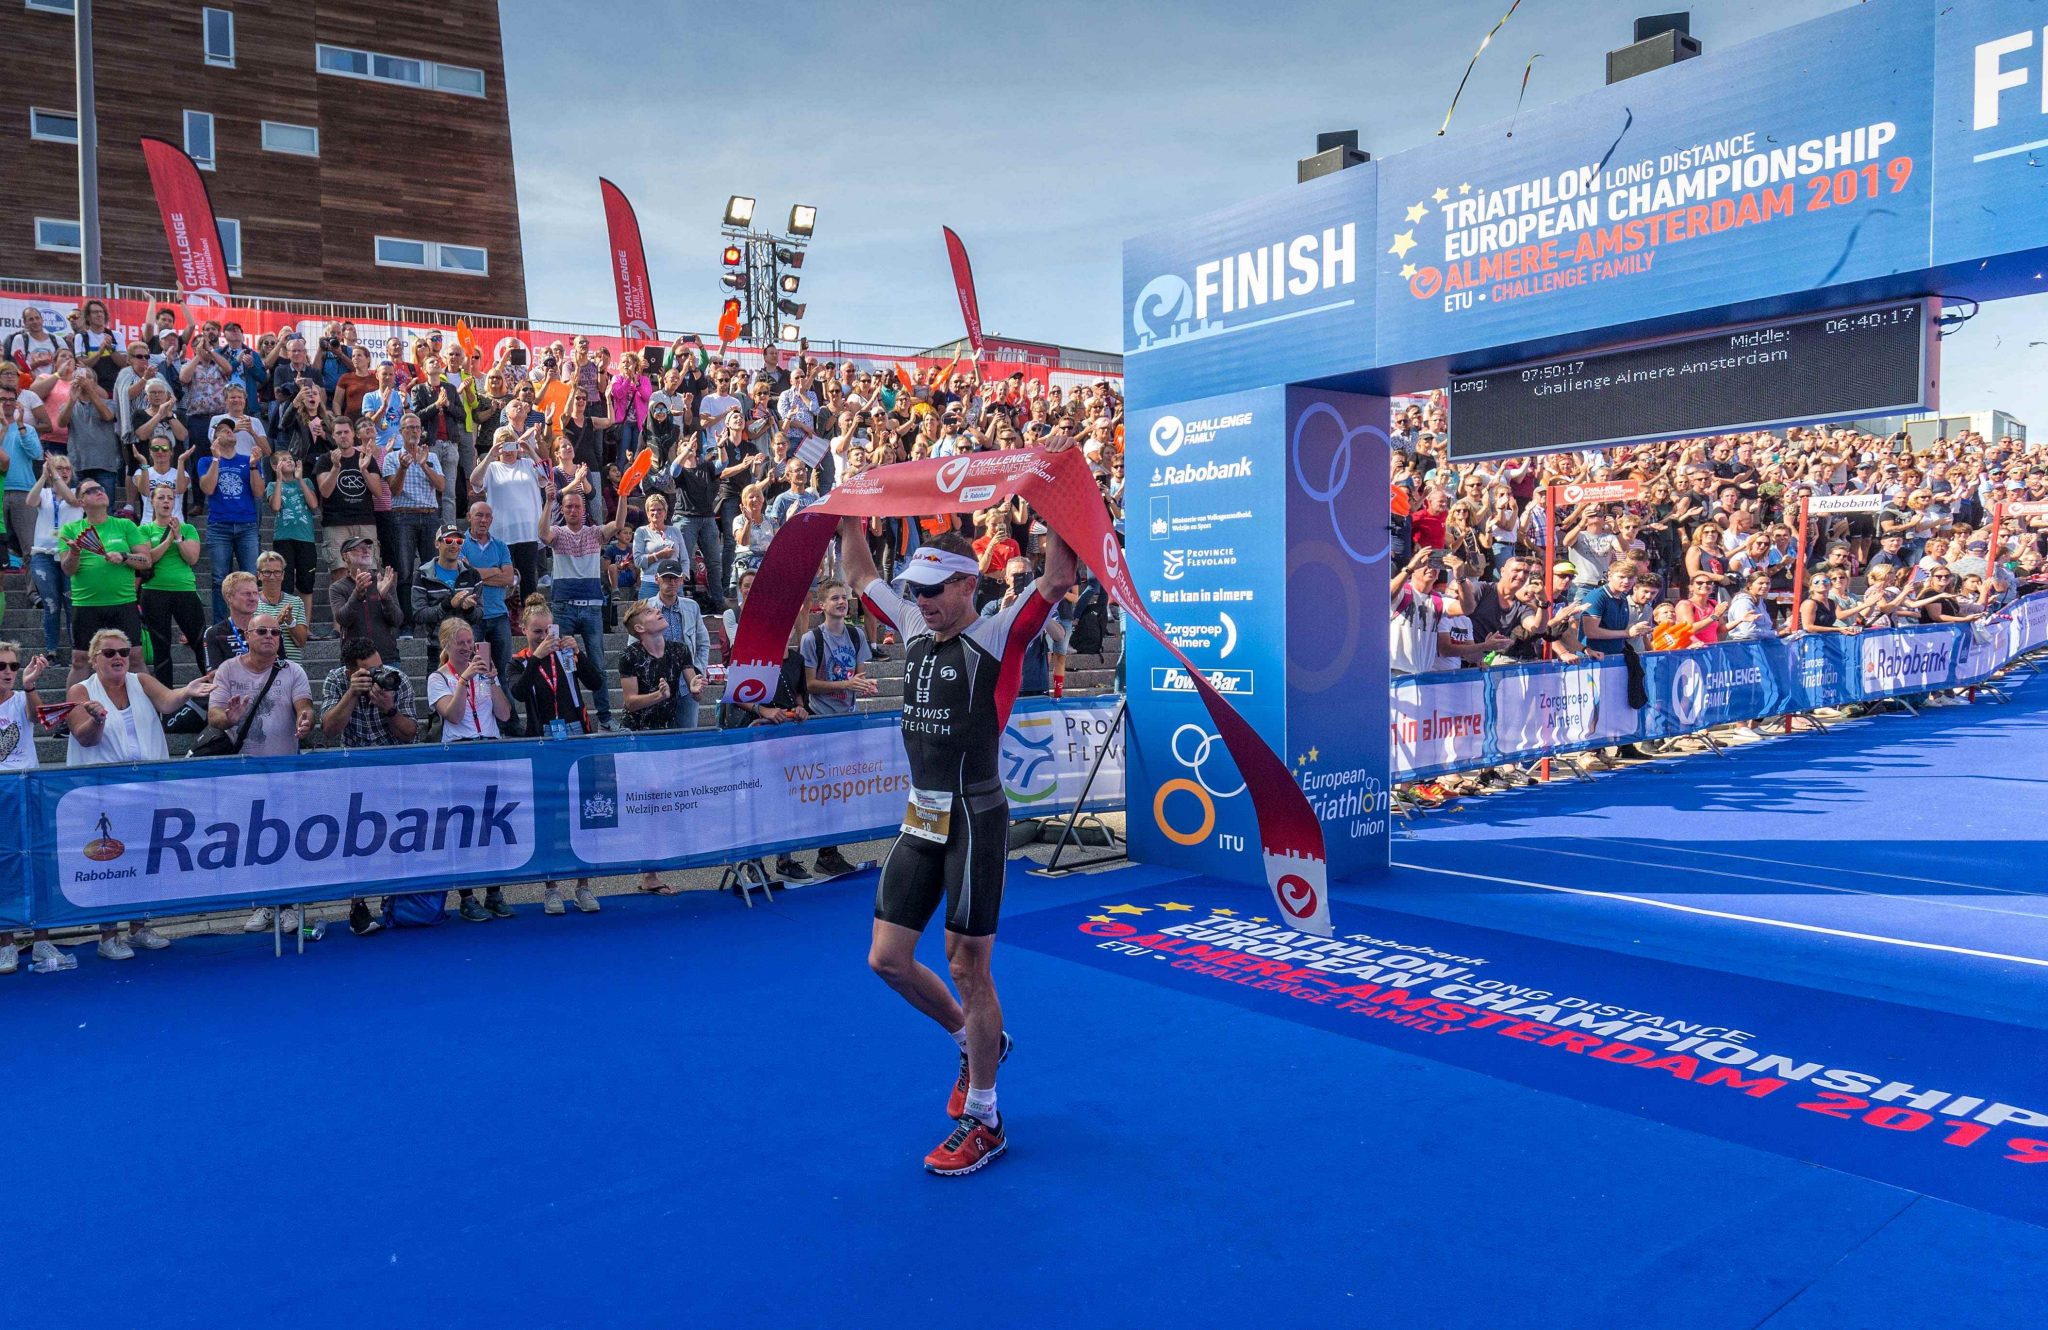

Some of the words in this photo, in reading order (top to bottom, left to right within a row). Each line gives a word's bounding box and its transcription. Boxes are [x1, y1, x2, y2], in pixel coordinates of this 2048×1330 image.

[1441, 162, 1601, 231] TRIATHLON
[1606, 160, 1654, 190] LONG
[1659, 131, 1756, 176] DISTANCE
[1444, 196, 1598, 262] EUROPEAN
[1608, 121, 1896, 221] CHAMPIONSHIP
[1444, 184, 1794, 292] ALMERE-AMSTERDAM
[1807, 156, 1913, 211] 2019
[171, 212, 198, 287] CHALLENGE
[192, 251, 209, 287] FAMILY
[618, 249, 634, 318] CHALLENGE
[1196, 222, 1356, 320] FINISH
[1444, 291, 1473, 313] ETU
[1492, 265, 1588, 302] CHALLENGE
[1592, 250, 1656, 282] FAMILY
[632, 286, 643, 319] FAMILY
[1454, 379, 1488, 393] Long:
[1521, 361, 1585, 382] 07:50:17
[1730, 330, 1791, 349] Middle:
[1825, 307, 1914, 334] 06:40:17
[1533, 375, 1611, 396] Challenge
[1615, 364, 1675, 384] Almere
[1680, 349, 1788, 375] Amsterdam
[1185, 412, 1253, 434] CHALLENGE
[1184, 431, 1216, 446] FAMILY
[970, 452, 1035, 468] CHALLENGE
[1164, 456, 1252, 486] Rabobank
[1819, 497, 1880, 509] Rabobank
[1187, 557, 1237, 567] FLEVOLAND
[1162, 591, 1179, 602] het
[1180, 590, 1200, 602] kan
[1200, 589, 1210, 602] in
[1213, 589, 1253, 602] almere
[1164, 622, 1223, 638] Zorggroep
[1171, 638, 1210, 649] Almere
[1877, 643, 1948, 679] Rabobank
[1706, 666, 1762, 690] CHALLENGE
[916, 707, 951, 720] SWISS
[1540, 691, 1589, 710] Zorggroep
[901, 719, 951, 735] STEALTH
[1402, 713, 1418, 744] in
[1422, 709, 1482, 741] almere
[1549, 713, 1580, 728] Almere
[784, 763, 826, 783] VWS
[828, 760, 884, 777] investeert
[1302, 768, 1366, 791] European
[625, 788, 672, 802] Ministerie
[674, 788, 689, 797] van
[690, 779, 763, 797] Volksgezondheid,
[789, 787, 798, 796] in
[800, 772, 911, 806] topsporters
[625, 801, 659, 815] Welzijn
[661, 804, 672, 812] en
[674, 800, 699, 814] Sport
[145, 784, 520, 875] Rabobank
[1219, 833, 1244, 852] ITU
[1350, 817, 1385, 839] Union
[74, 867, 138, 883] Rabobank
[1344, 934, 1490, 966] Rabobank
[1096, 941, 1156, 957] ETU
[1170, 959, 1342, 1003] CHALLENGE
[1335, 1000, 1466, 1035] FAMILY
[1199, 915, 1460, 979] TRIATHLON
[1454, 973, 1553, 1001] LONG
[1556, 996, 1756, 1044] DISTANCE
[1157, 924, 1432, 988] EUROPEAN
[1429, 983, 2048, 1127] CHAMPIONSHIP
[1122, 935, 1788, 1098] ALMERE-AMSTERDAM
[1796, 1091, 2048, 1163] 2019
